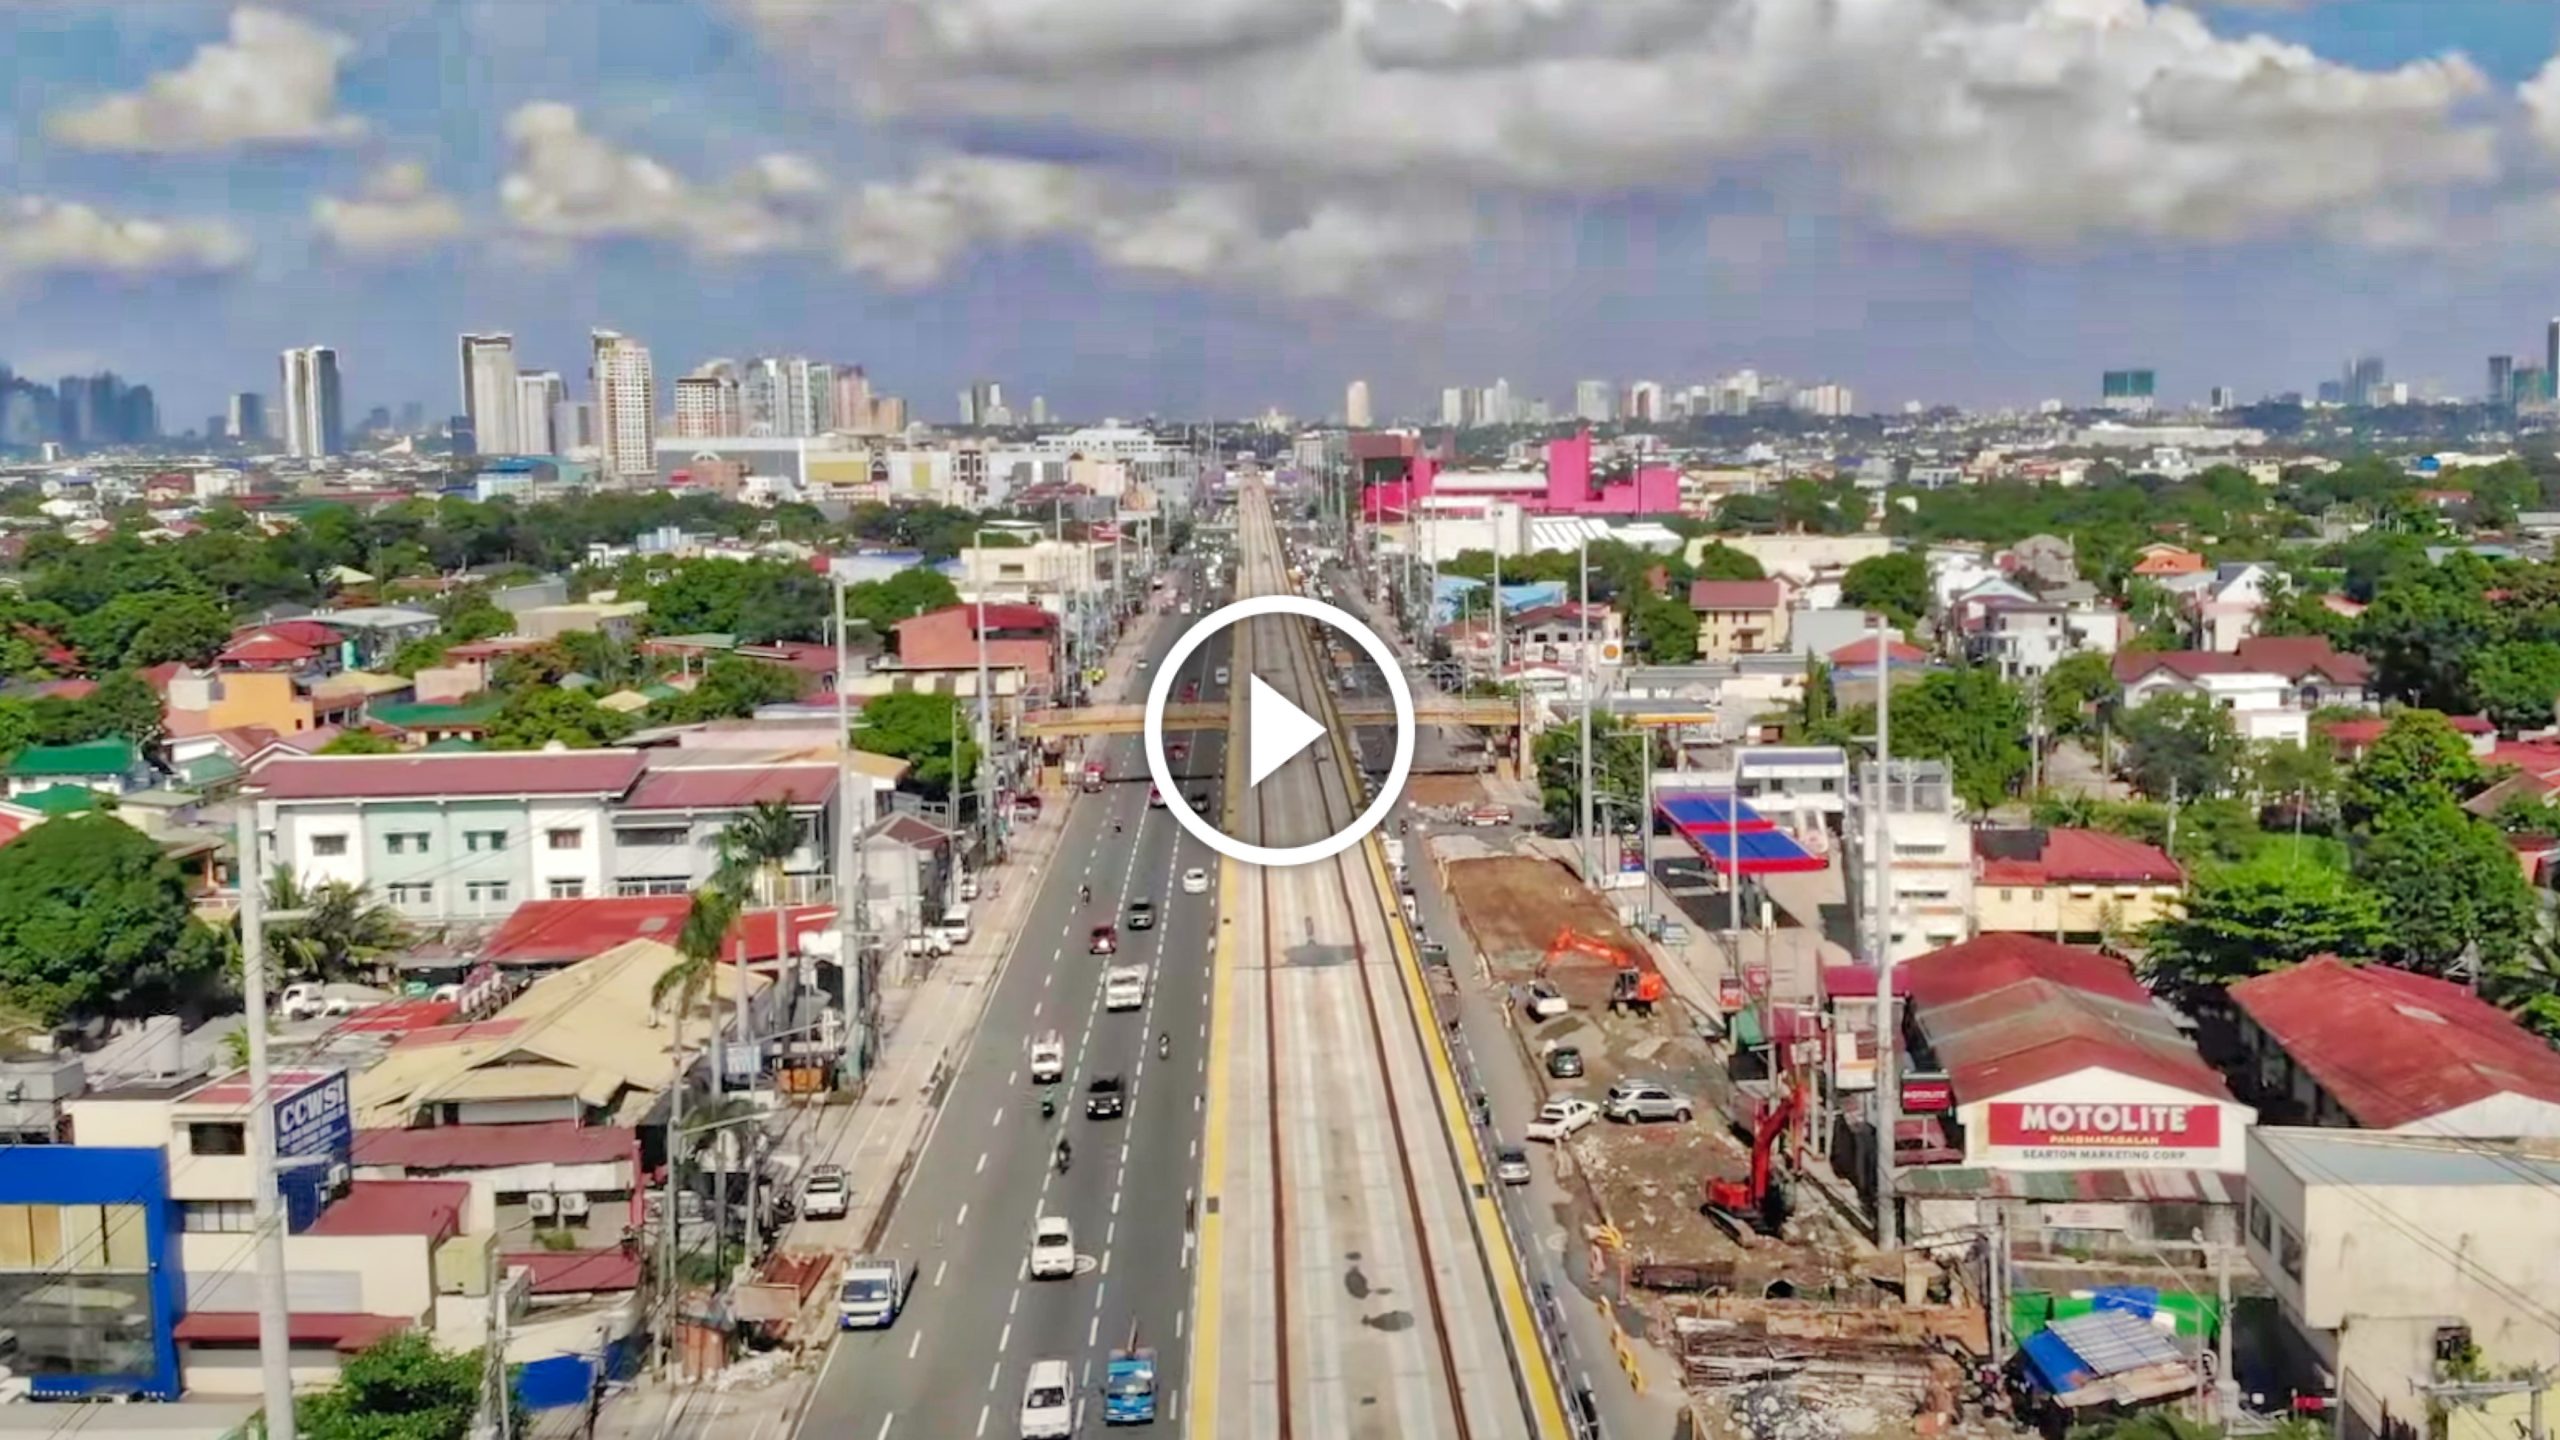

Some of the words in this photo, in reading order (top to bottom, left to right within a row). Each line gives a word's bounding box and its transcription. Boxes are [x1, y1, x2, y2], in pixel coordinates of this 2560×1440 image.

[280, 1077, 345, 1132] CCWSI
[2020, 1104, 2188, 1132] MOTOLITE
[2080, 1150, 2149, 1161] MARKETING
